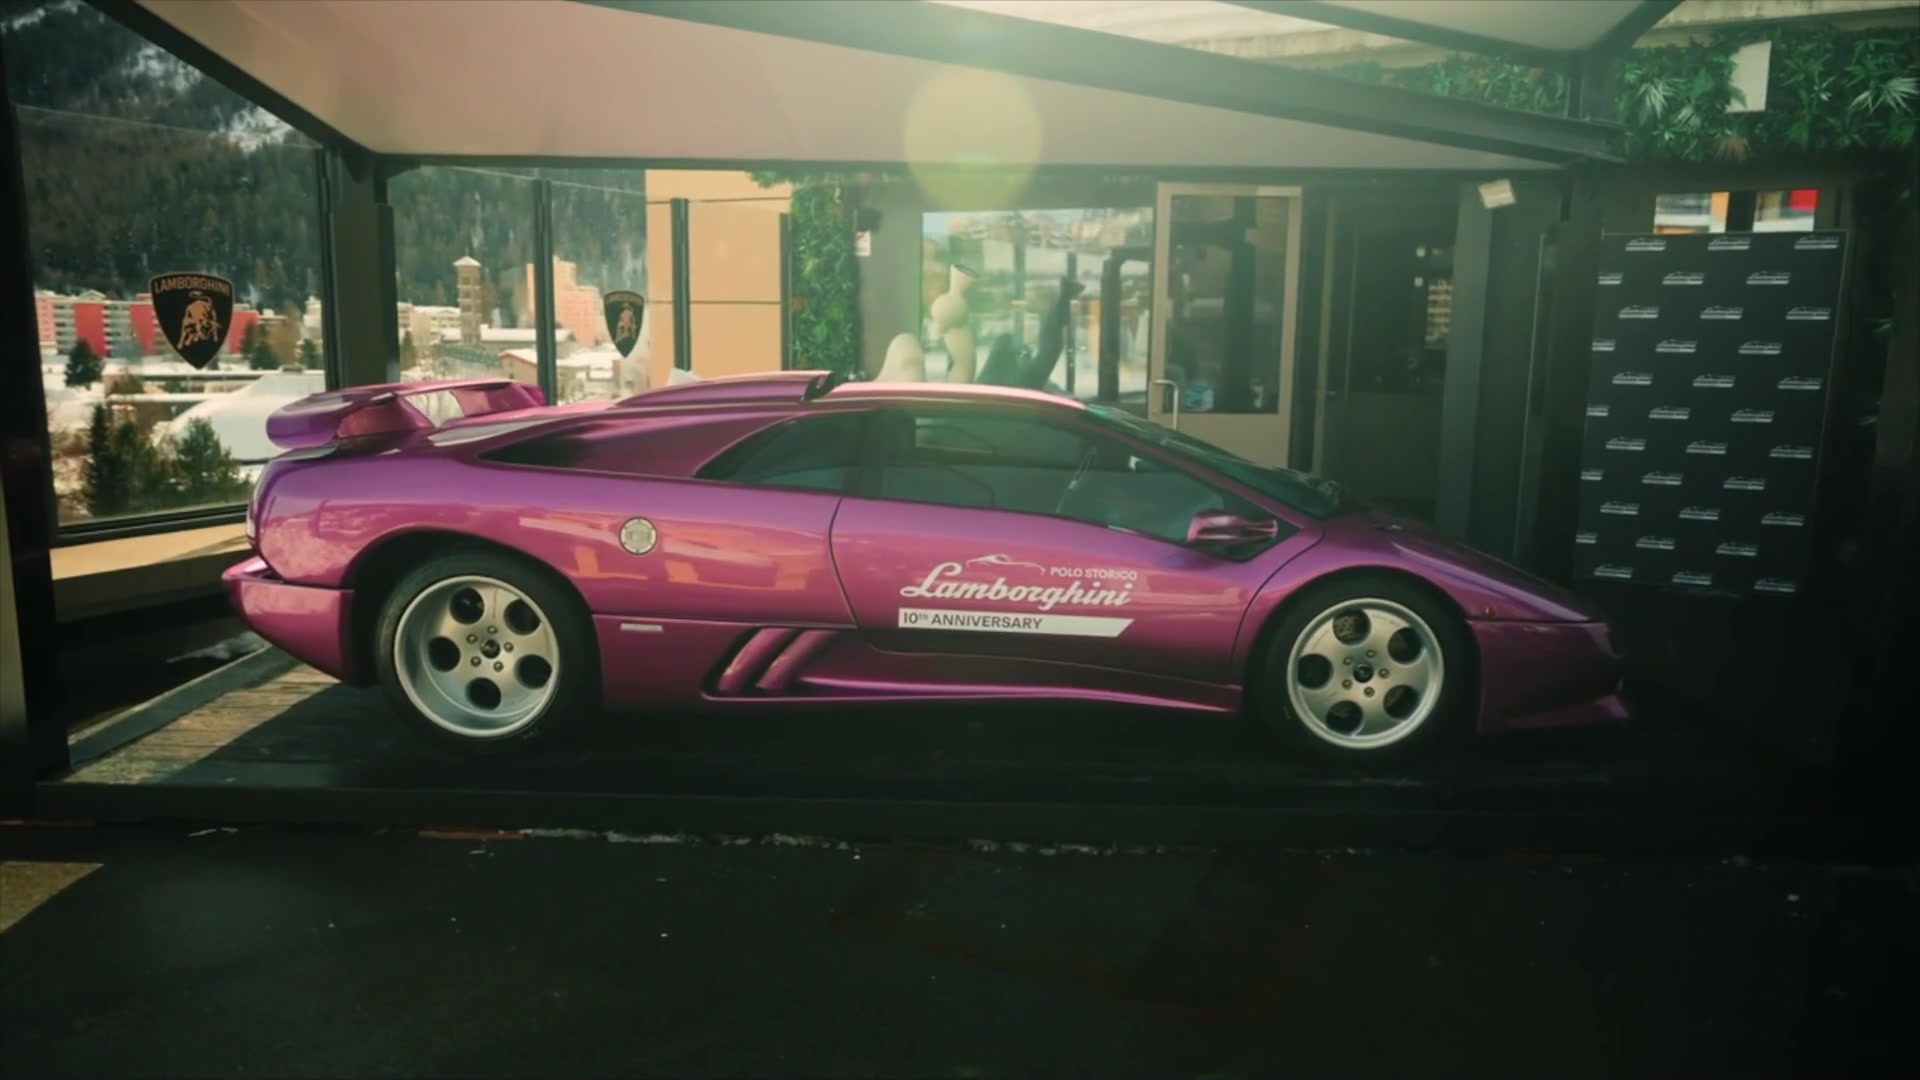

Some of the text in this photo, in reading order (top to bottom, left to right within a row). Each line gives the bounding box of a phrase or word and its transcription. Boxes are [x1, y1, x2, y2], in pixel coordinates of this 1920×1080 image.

[153, 276, 231, 297] LAMBORGHINI
[1050, 567, 1138, 581] POLO STORICO
[900, 562, 1134, 611] Lamborghini
[903, 612, 1043, 630] 10th ANNIVERSARY
